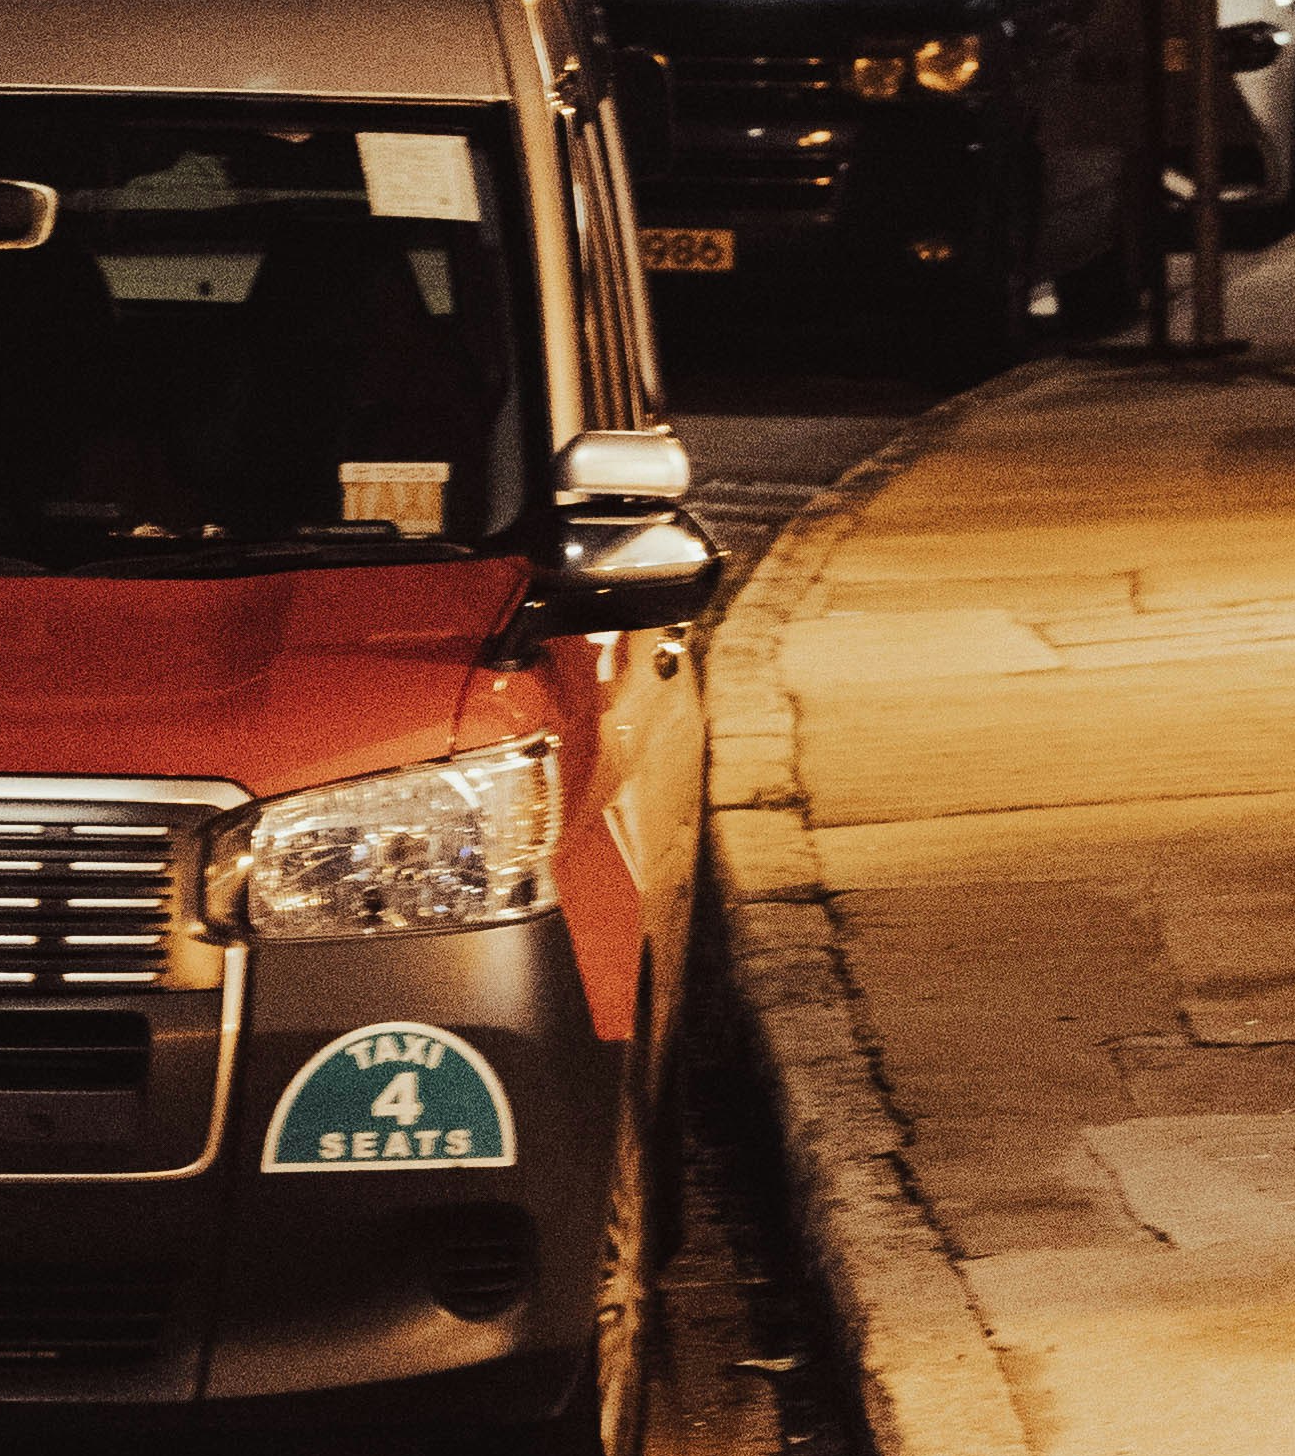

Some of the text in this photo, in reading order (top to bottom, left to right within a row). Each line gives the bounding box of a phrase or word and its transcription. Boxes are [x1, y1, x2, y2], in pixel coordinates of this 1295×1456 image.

[345, 1035, 447, 1070] TAXI
[371, 1071, 424, 1126] 4
[317, 1129, 473, 1160] SEATS
